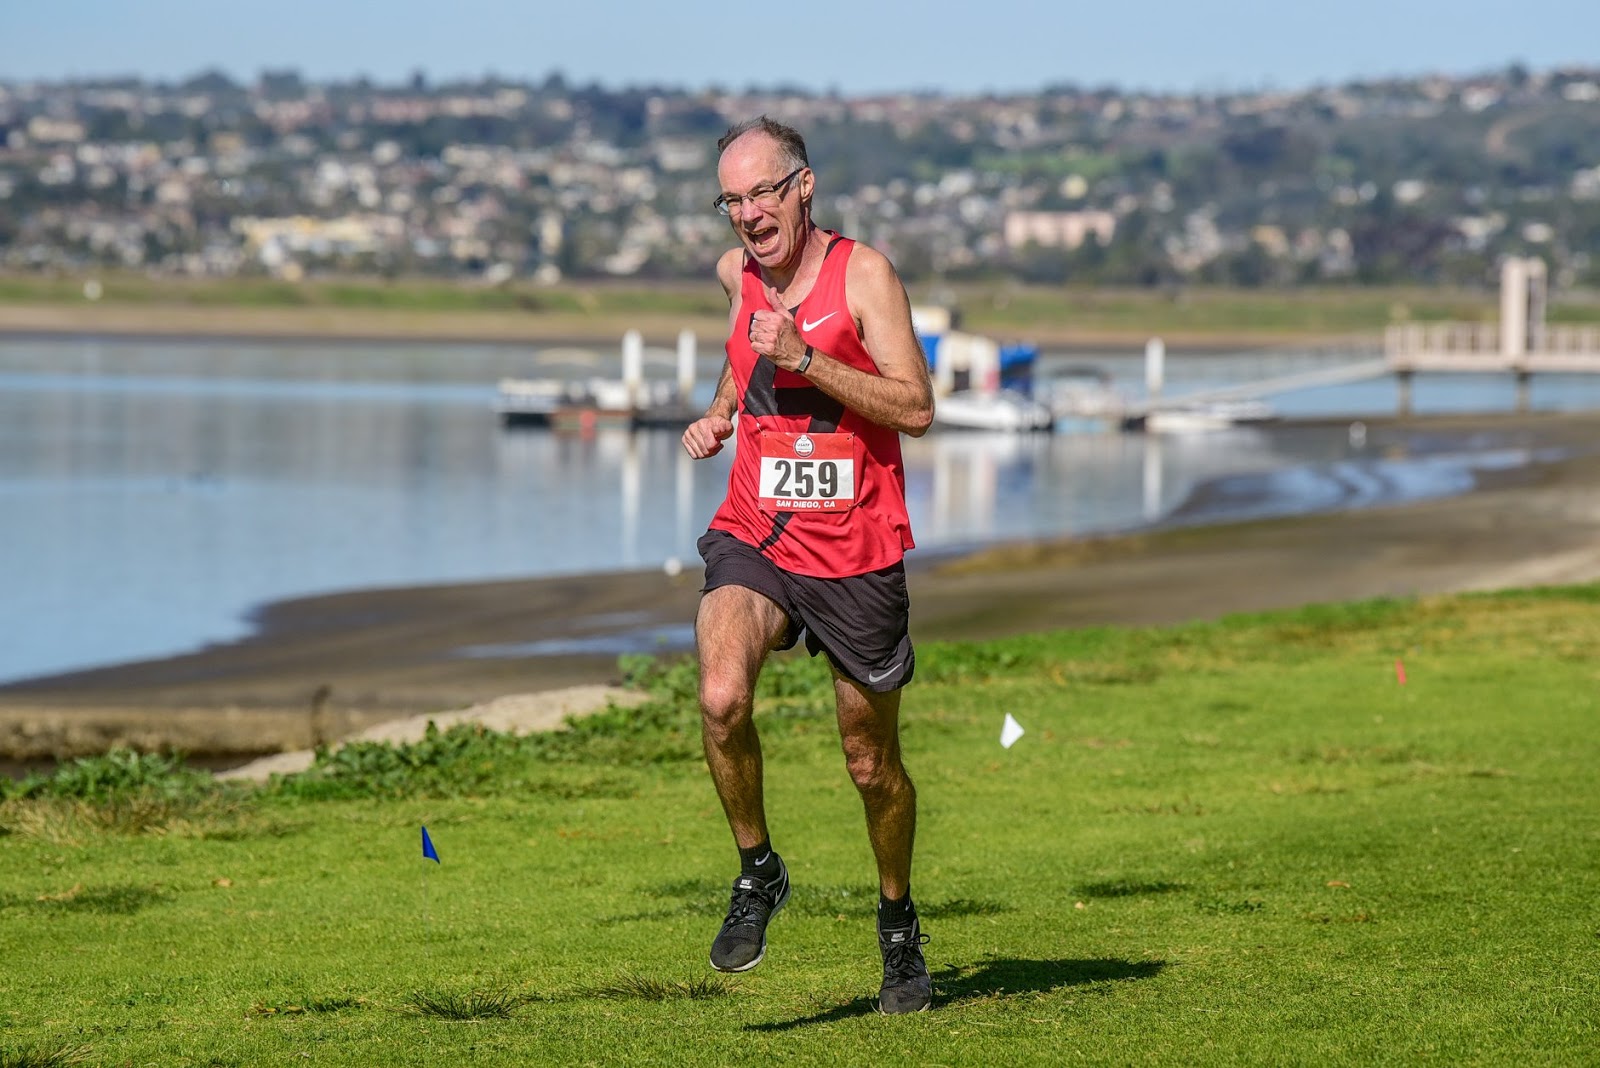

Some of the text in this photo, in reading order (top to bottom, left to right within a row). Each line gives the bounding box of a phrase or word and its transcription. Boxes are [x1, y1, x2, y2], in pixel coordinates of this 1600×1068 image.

[773, 459, 838, 498] 259
[776, 500, 791, 508] SAN
[793, 501, 821, 509] DIEGO,
